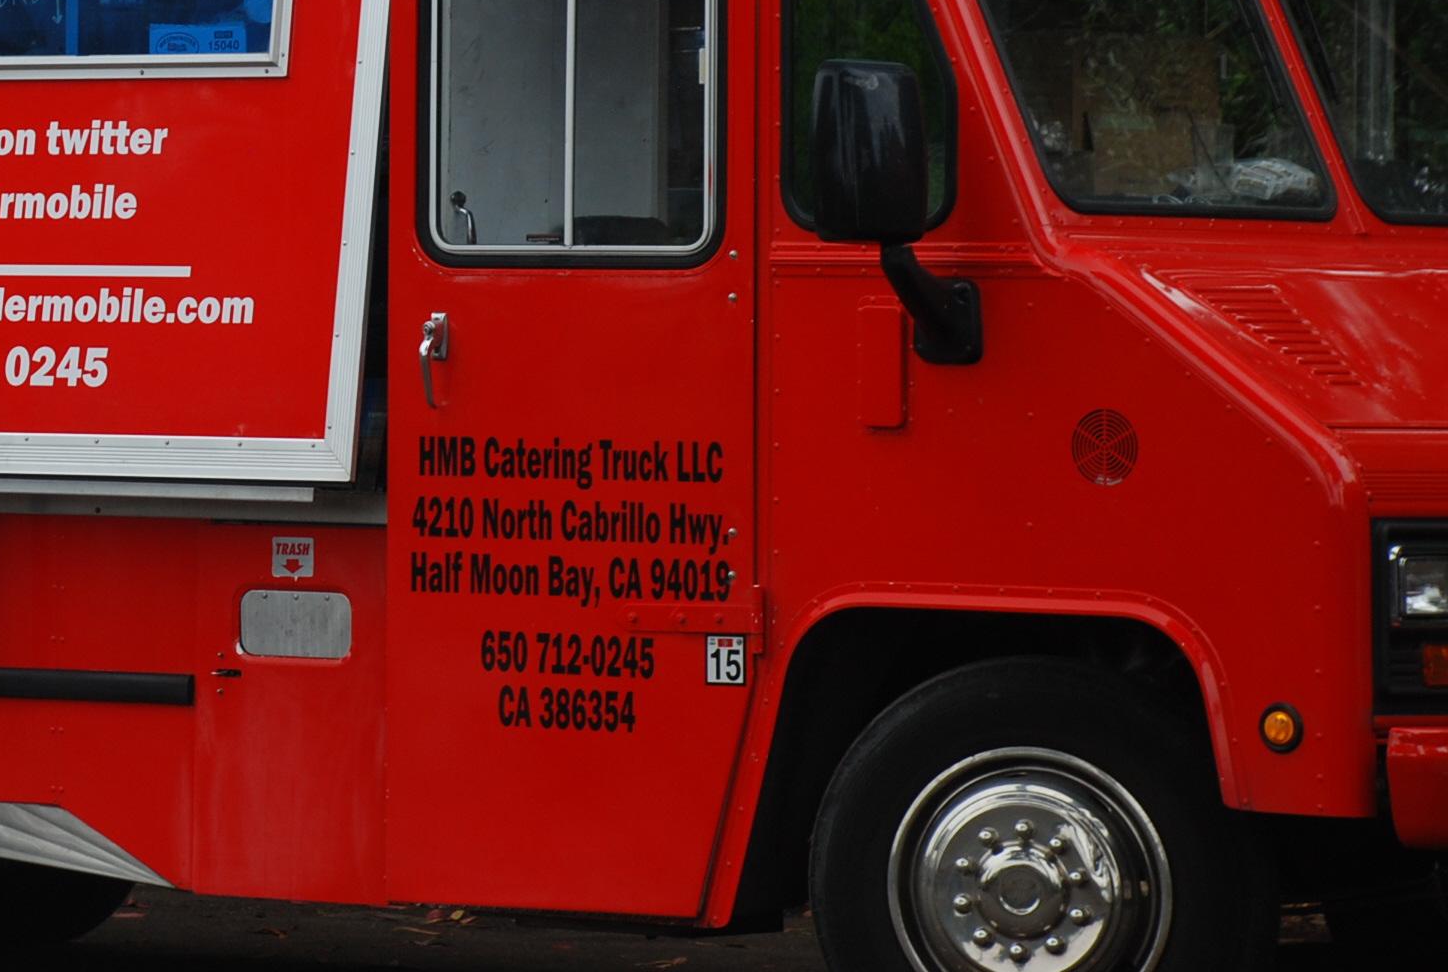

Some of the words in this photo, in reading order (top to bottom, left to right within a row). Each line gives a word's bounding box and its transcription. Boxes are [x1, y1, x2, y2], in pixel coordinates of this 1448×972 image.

[46, 119, 169, 156] twitter
[5, 345, 109, 388] 0245
[419, 435, 476, 477] HMB
[484, 436, 593, 490] Catering
[599, 439, 669, 482] Truck
[677, 441, 723, 483] LLC
[276, 542, 310, 556] TRASH
[412, 496, 474, 538] 4210
[482, 498, 553, 540] North
[561, 499, 661, 544] Cabrillo
[669, 503, 729, 555] Hwy.
[411, 551, 463, 593] Half
[470, 553, 539, 596] Moon
[548, 555, 601, 607] Bay,
[608, 557, 643, 599] CA
[650, 558, 731, 602] 94019
[481, 630, 528, 673] 650
[536, 632, 655, 680] 712-0245
[711, 648, 741, 681] 15
[498, 685, 532, 727] CA
[539, 687, 636, 733] 386354
